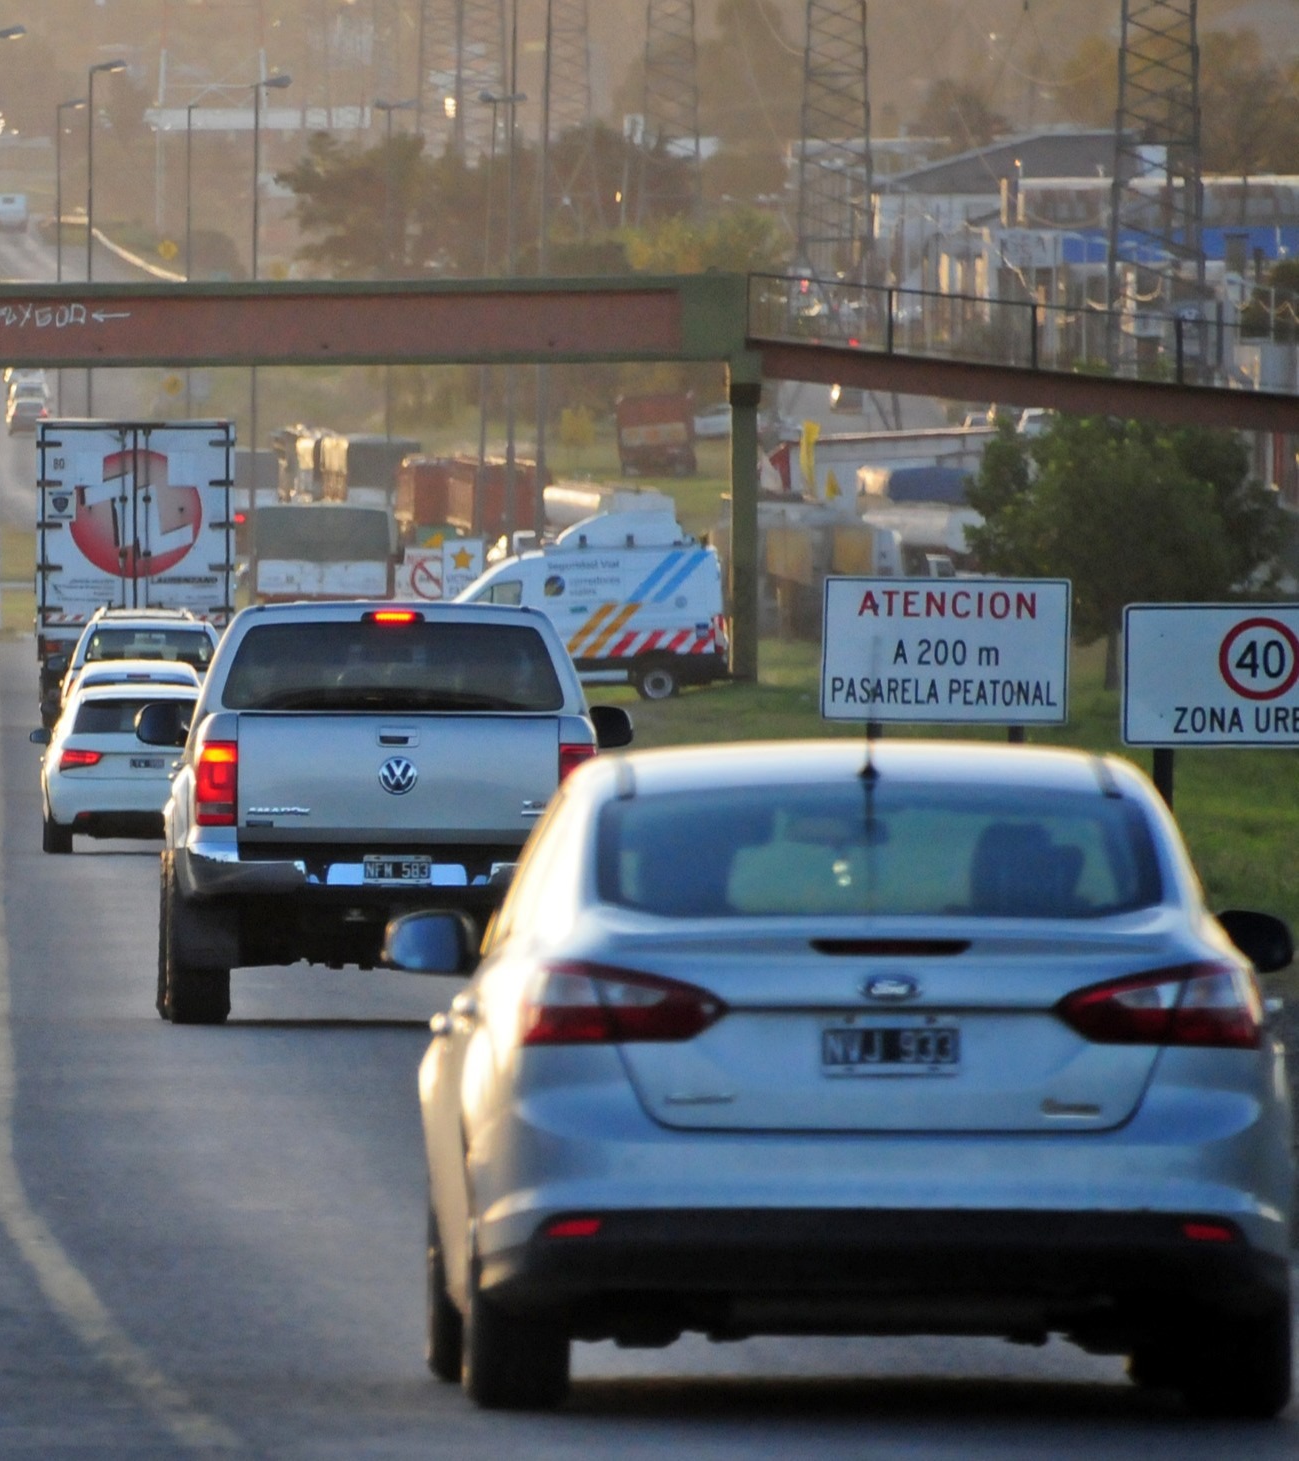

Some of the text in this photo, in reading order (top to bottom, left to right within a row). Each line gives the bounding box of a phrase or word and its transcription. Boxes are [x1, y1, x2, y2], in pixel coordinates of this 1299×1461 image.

[601, 560, 619, 568] Vial
[858, 590, 1037, 619] ATENCION
[893, 639, 1000, 666] A 200 m
[1235, 640, 1287, 679] 40
[831, 677, 1058, 707] PASARELA PEATONAL
[1173, 706, 1245, 734] ZONA
[365, 862, 429, 878] NFM 583
[824, 1031, 952, 1063] NVJ 933
